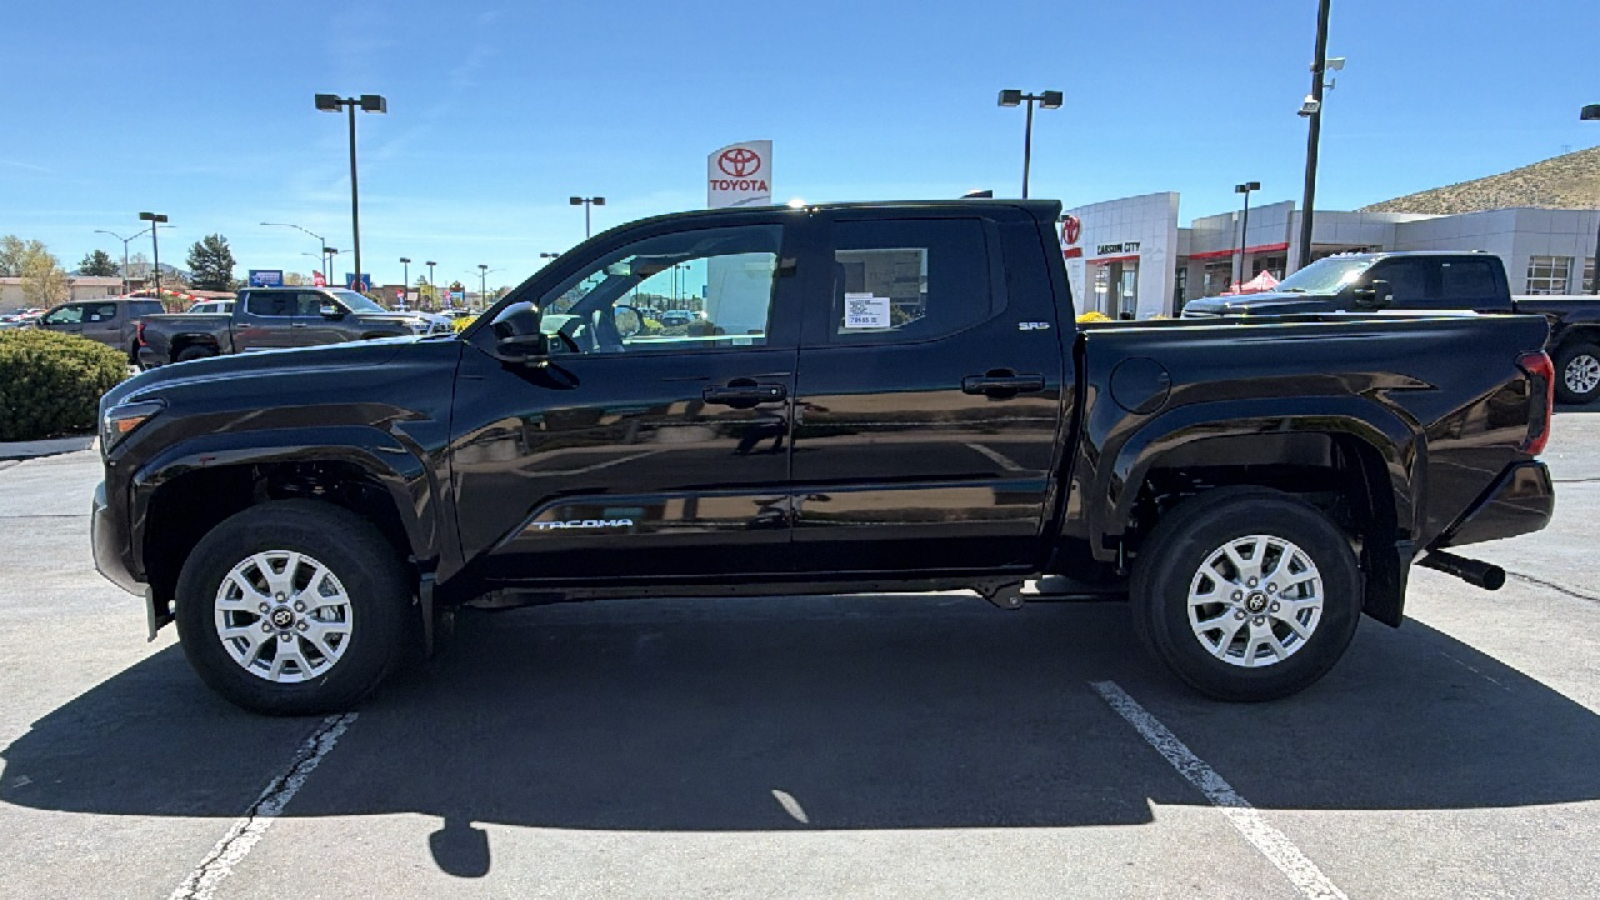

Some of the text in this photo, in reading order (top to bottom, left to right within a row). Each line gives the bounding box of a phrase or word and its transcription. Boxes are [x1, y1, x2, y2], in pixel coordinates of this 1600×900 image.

[709, 179, 768, 191] TOYOTA
[1124, 241, 1140, 253] CITY
[1018, 321, 1051, 331] SR5
[531, 518, 633, 530] TACOMA
